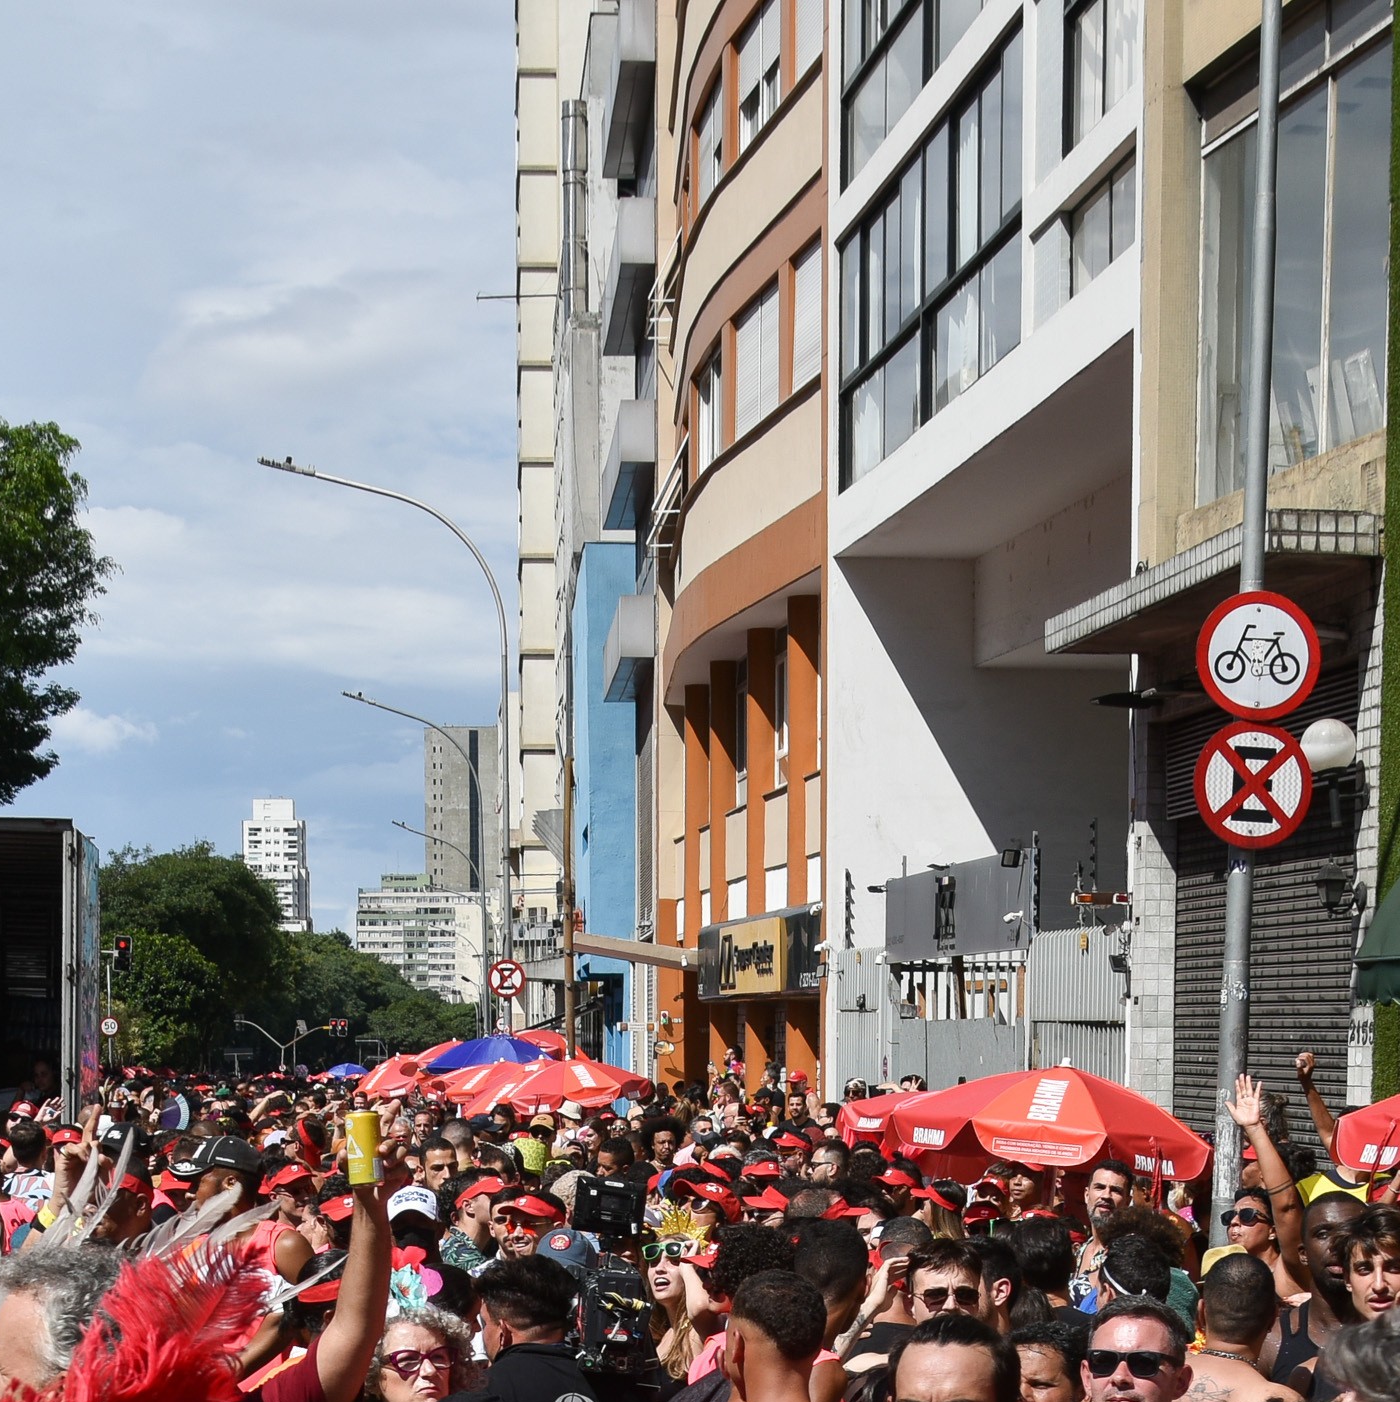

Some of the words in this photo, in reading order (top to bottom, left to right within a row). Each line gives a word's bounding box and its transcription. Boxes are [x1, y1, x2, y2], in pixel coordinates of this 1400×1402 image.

[104, 1021, 117, 1030] 50
[1026, 1078, 1070, 1122] BRAHMA
[912, 1126, 946, 1146] BRAHMA
